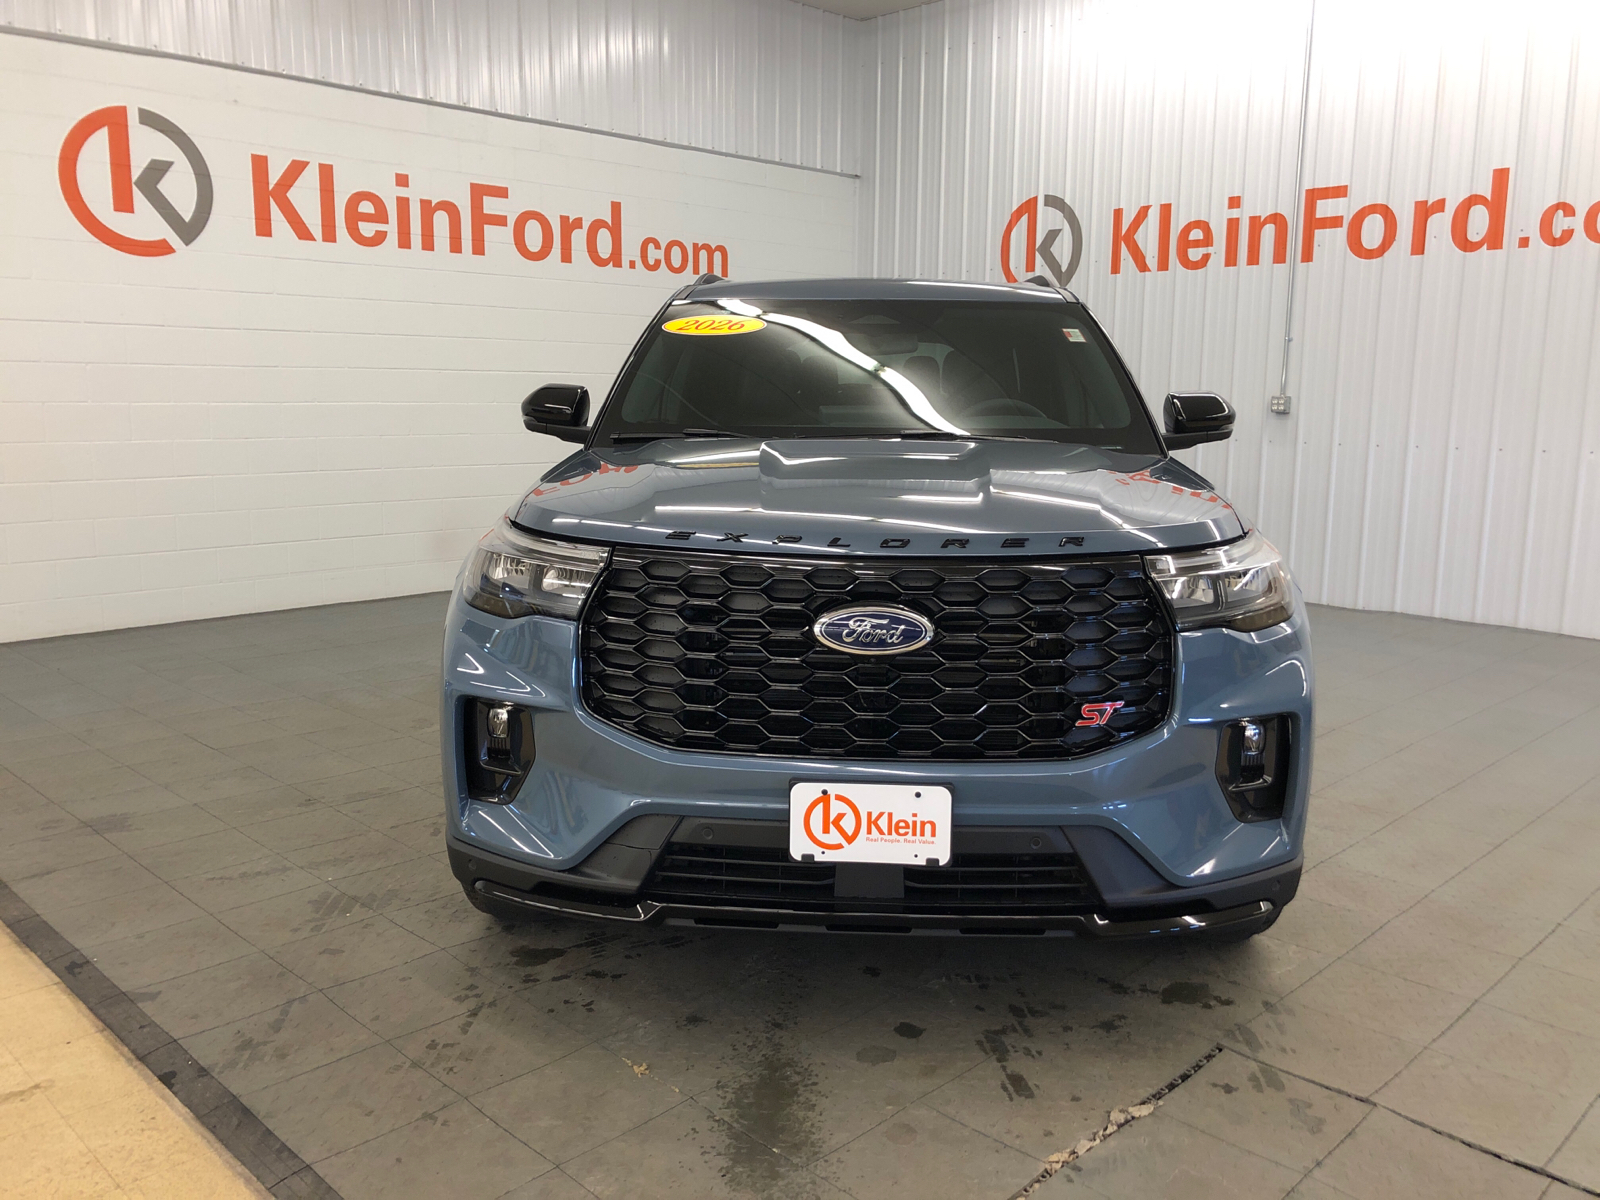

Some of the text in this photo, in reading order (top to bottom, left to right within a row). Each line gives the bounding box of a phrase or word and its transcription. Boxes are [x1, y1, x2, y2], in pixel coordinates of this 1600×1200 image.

[250, 153, 730, 278] KleinFord.com
[676, 319, 752, 331] 2026
[665, 530, 1085, 549] EXPLORER
[842, 616, 904, 643] Ford
[1075, 701, 1125, 727] ST
[866, 811, 937, 838] Klein
